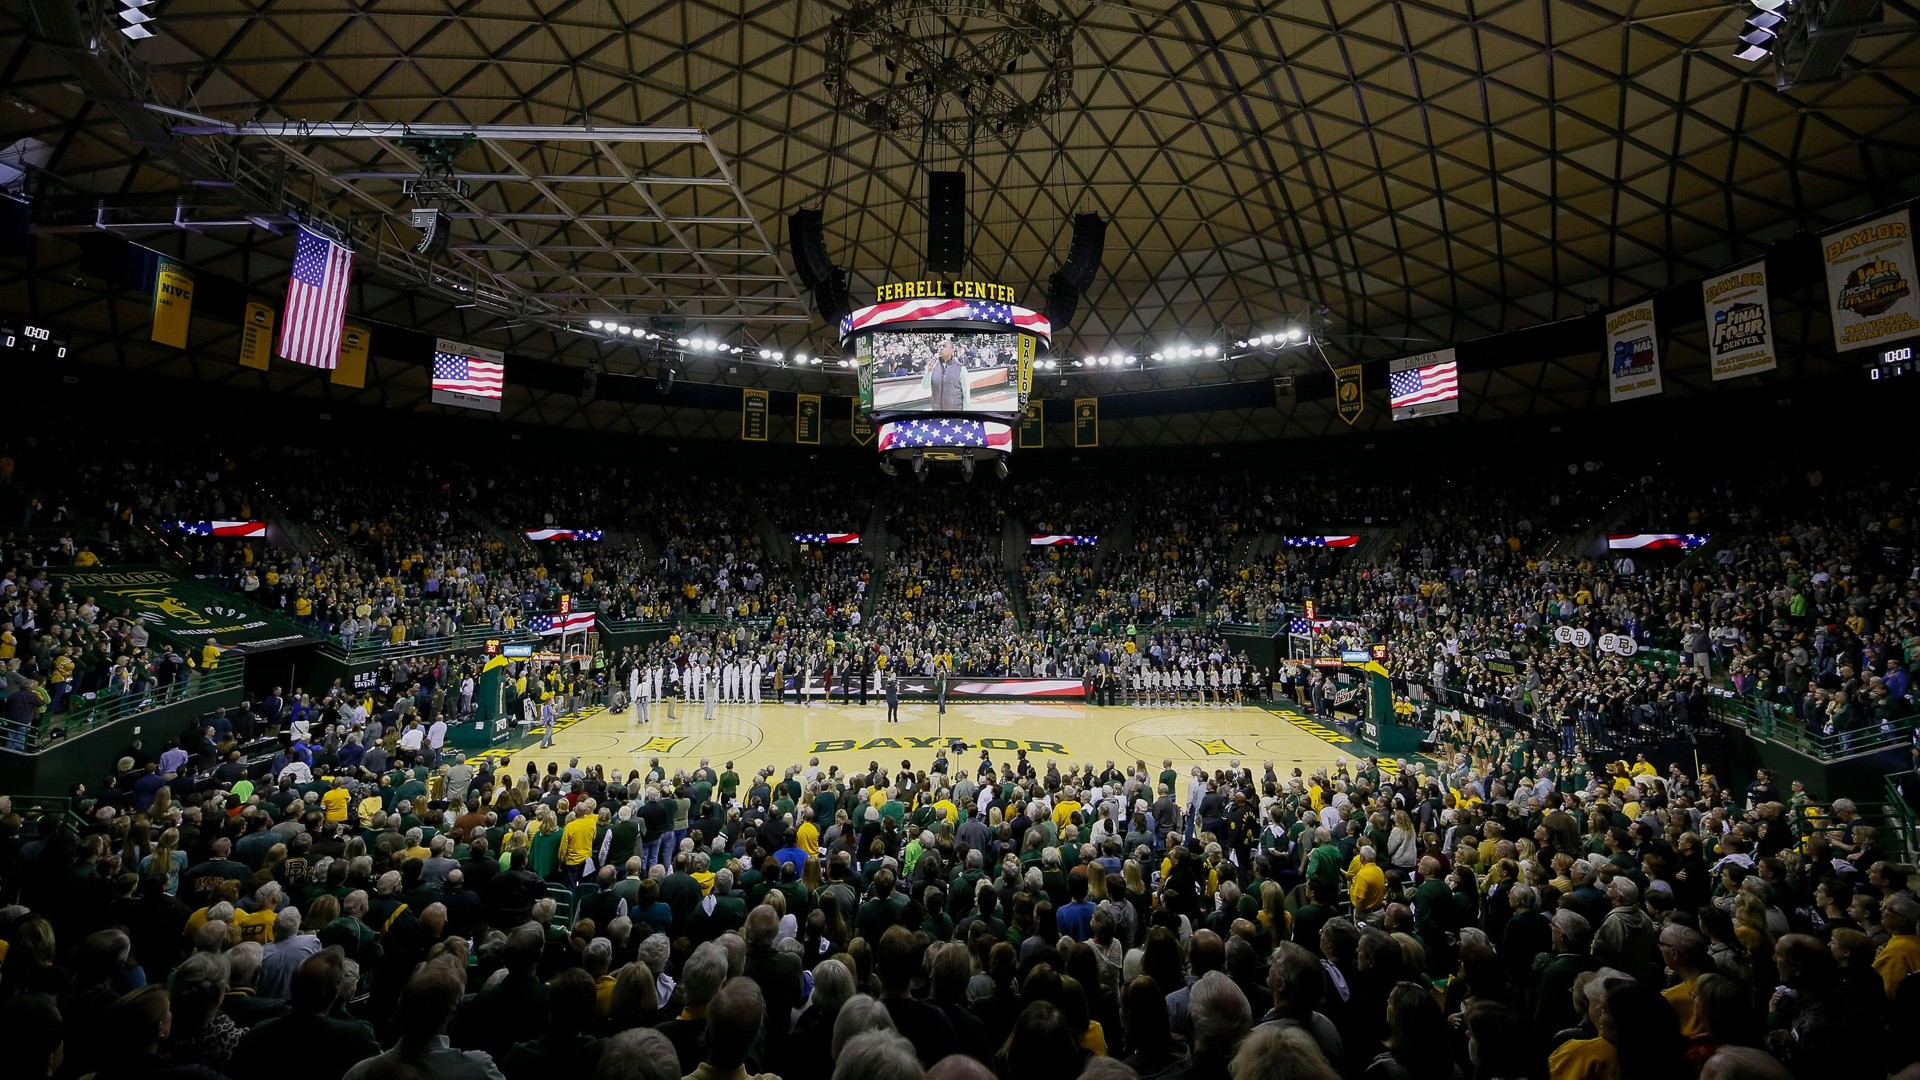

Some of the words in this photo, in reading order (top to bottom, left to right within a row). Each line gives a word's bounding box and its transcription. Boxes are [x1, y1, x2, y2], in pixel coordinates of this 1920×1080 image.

[1827, 223, 1906, 262] BAYLOR
[162, 283, 190, 299] NIVC
[877, 280, 946, 302] FERRELL
[953, 281, 1015, 303] CENTER
[1706, 272, 1763, 303] BAYLOR
[1845, 289, 1877, 307] FINAL
[1875, 279, 1907, 296] FOUR
[1846, 283, 1870, 297] NCAA
[1608, 309, 1652, 334] BAYLOR
[1728, 307, 1762, 326] FINAL
[1845, 312, 1911, 334] NATIONAL
[24, 326, 50, 340] 10:00
[1714, 319, 1764, 346] FOUR
[1723, 335, 1760, 352] DENVER
[1840, 320, 1919, 345] CHAMPIONS
[6, 336, 16, 347] 0
[58, 347, 66, 358] 0
[1885, 348, 1910, 362] 10:00
[1020, 338, 1030, 403] BAYLOR
[1871, 368, 1879, 380] 0
[1575, 631, 1587, 646] BU
[1619, 638, 1633, 654] BU
[1268, 709, 1353, 744] BAYLOR
[810, 736, 1069, 754] BAYLOR
